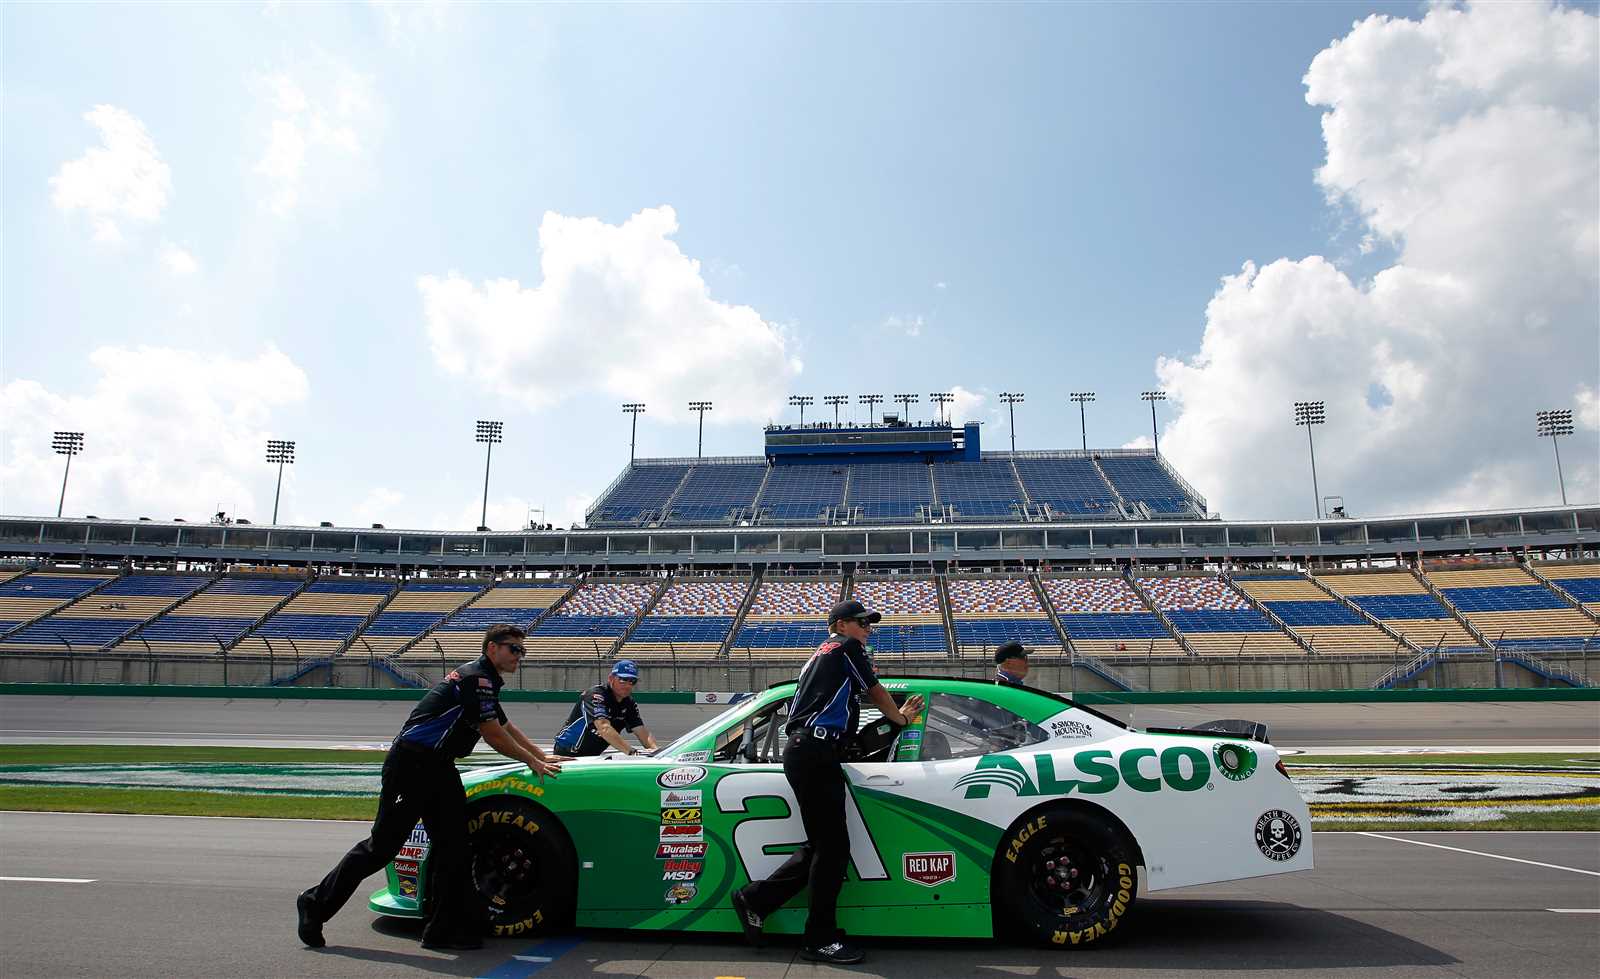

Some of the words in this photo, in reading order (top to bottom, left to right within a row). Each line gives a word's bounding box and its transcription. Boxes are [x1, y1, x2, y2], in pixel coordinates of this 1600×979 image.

[1057, 720, 1085, 729] SMOKEY
[1054, 727, 1093, 738] MOUNTAIN
[664, 773, 697, 783] xfinity
[953, 746, 1211, 800] ALSCO
[1219, 765, 1255, 780] ETHANOL
[1257, 810, 1279, 830] DEATH
[1281, 811, 1299, 829] WISH
[1006, 815, 1048, 863] EAGLE
[661, 845, 704, 854] Duralast
[1260, 845, 1293, 861] COFFEE
[664, 860, 702, 873] Holley
[909, 858, 928, 873] RED
[930, 858, 949, 872] KAP
[663, 871, 696, 881] MSD
[495, 910, 544, 936] EAGLE
